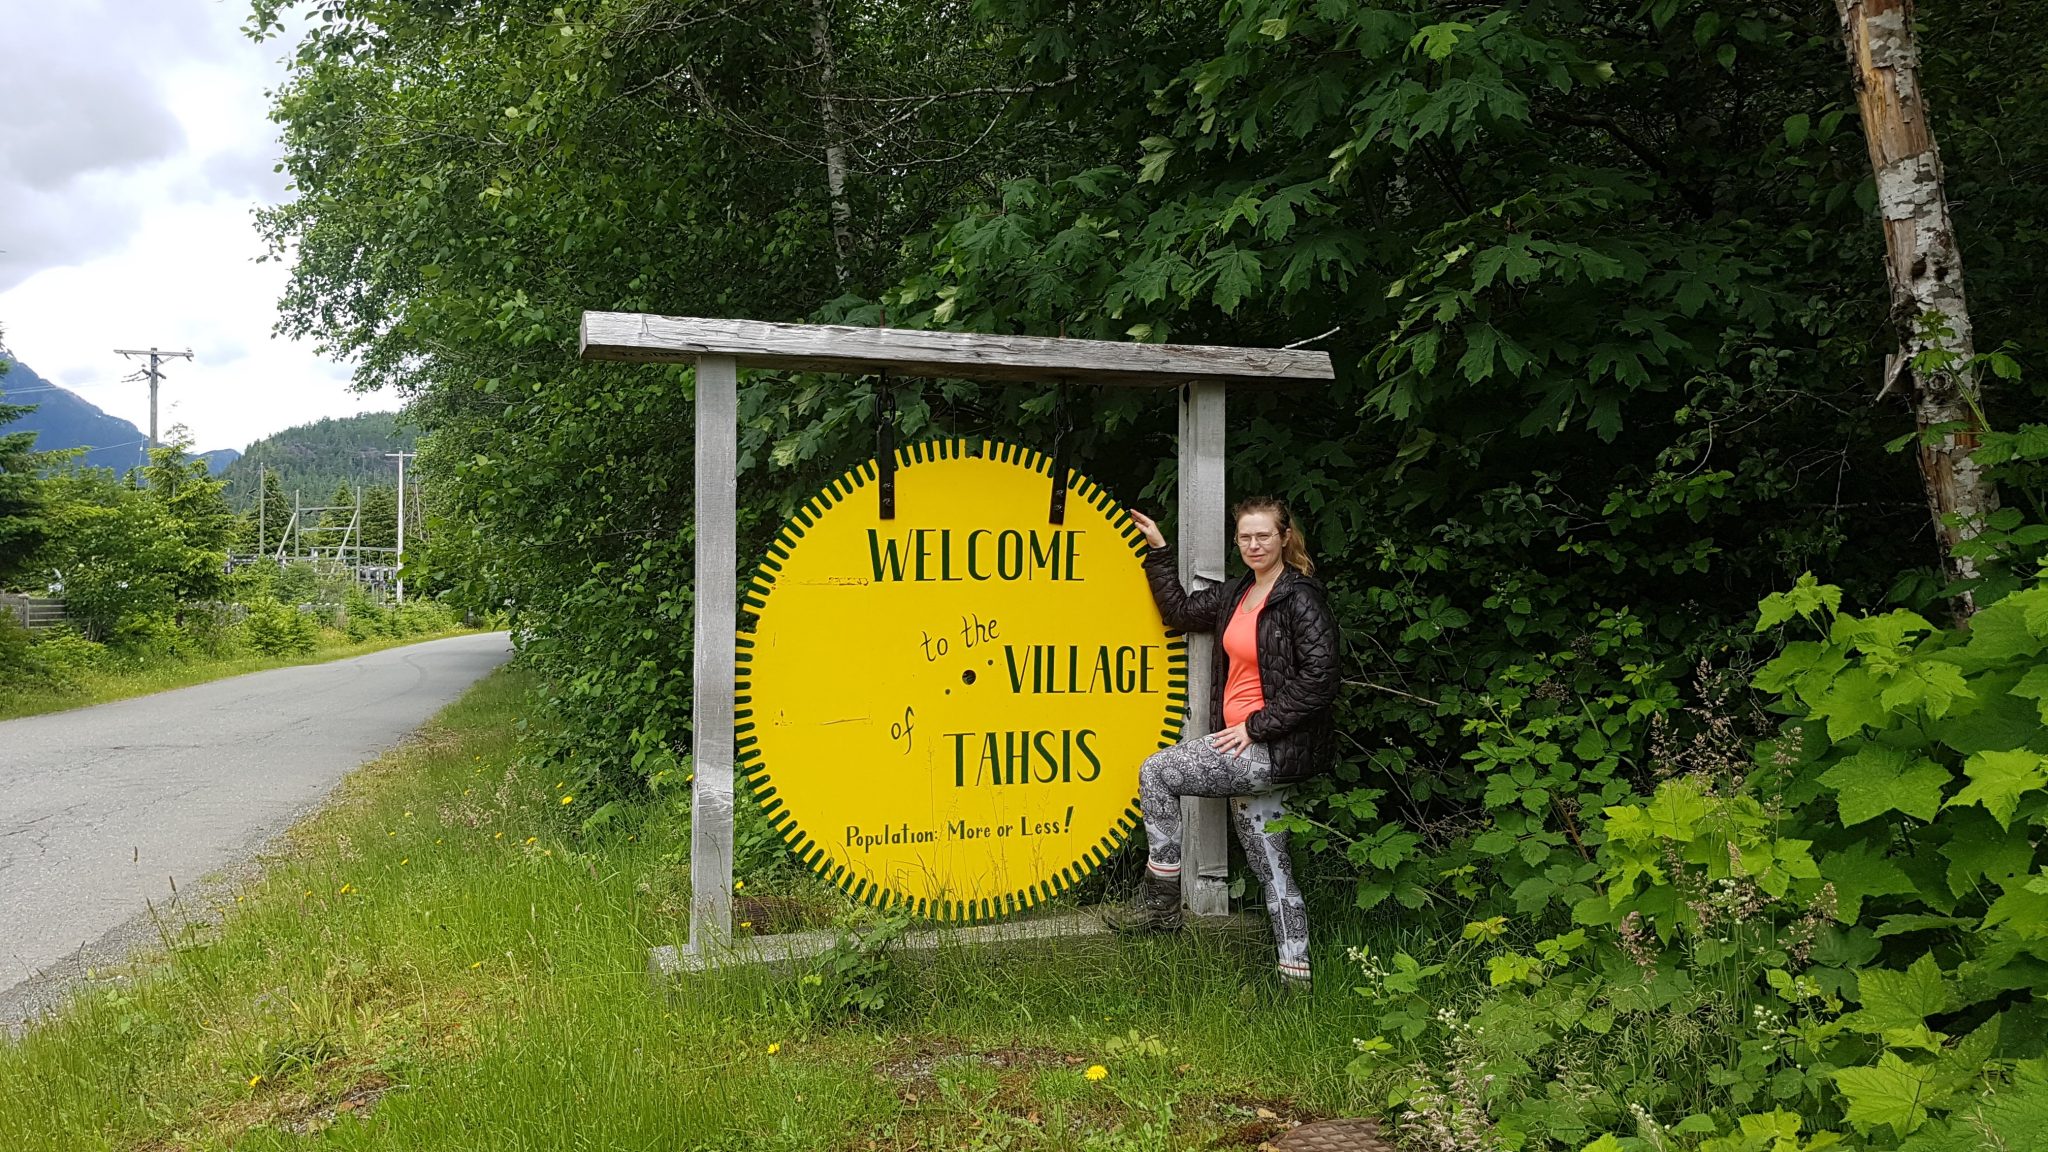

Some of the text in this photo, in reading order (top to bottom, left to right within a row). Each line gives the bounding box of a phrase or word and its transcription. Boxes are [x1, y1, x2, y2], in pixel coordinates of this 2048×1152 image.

[865, 528, 1086, 582] WELCOME
[920, 613, 1000, 662] to the
[1004, 645, 1160, 693] VILLAGE
[890, 706, 915, 755] of
[943, 729, 1102, 787] TAHSIS
[846, 805, 1074, 853] Population: More or Less!
